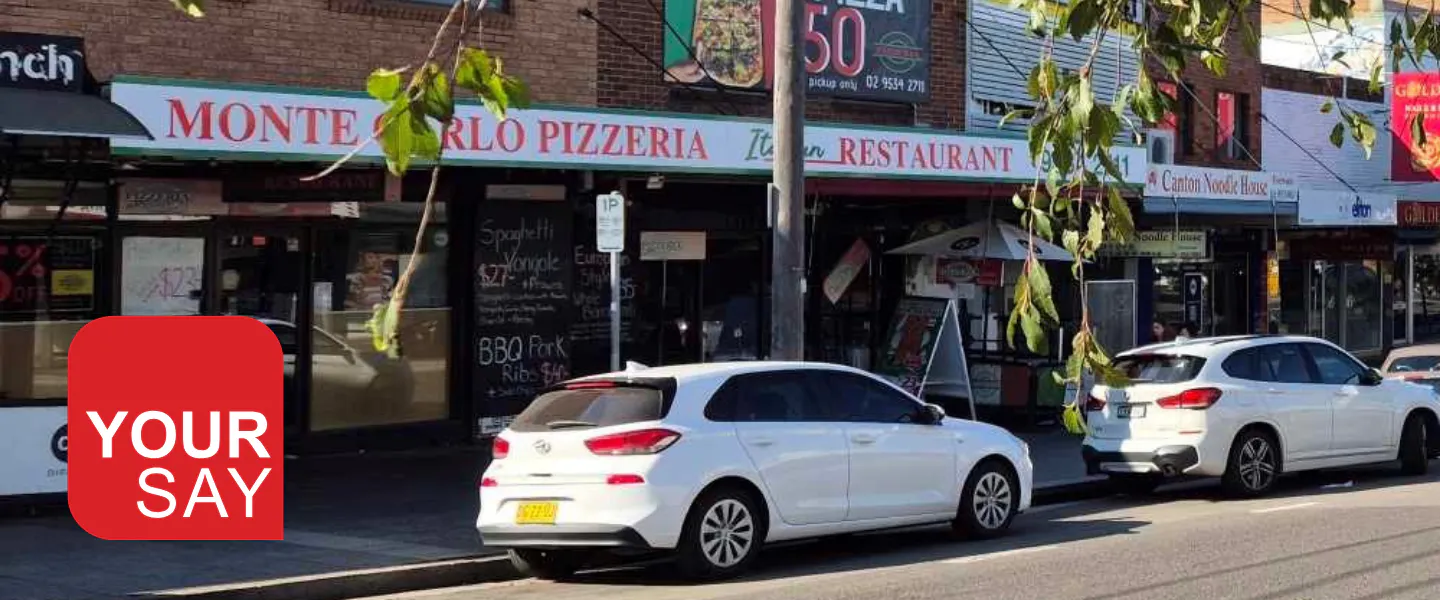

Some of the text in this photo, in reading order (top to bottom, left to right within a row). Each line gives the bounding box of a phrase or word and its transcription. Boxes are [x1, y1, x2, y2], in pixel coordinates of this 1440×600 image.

[804, 4, 866, 77] 50
[808, 77, 837, 91] pickup
[839, 80, 859, 92] only
[866, 74, 879, 90] 02
[166, 98, 361, 146] MONTE
[372, 112, 526, 153] RLO
[537, 119, 710, 161] PIZZERIA
[839, 136, 1013, 173] RESTAURANT
[1161, 169, 1201, 194] Canton
[1203, 172, 1239, 197] Noodle
[1240, 173, 1268, 197] House
[602, 198, 620, 213] 1P
[479, 217, 554, 252] Spaghetti
[478, 336, 523, 366] BBQ
